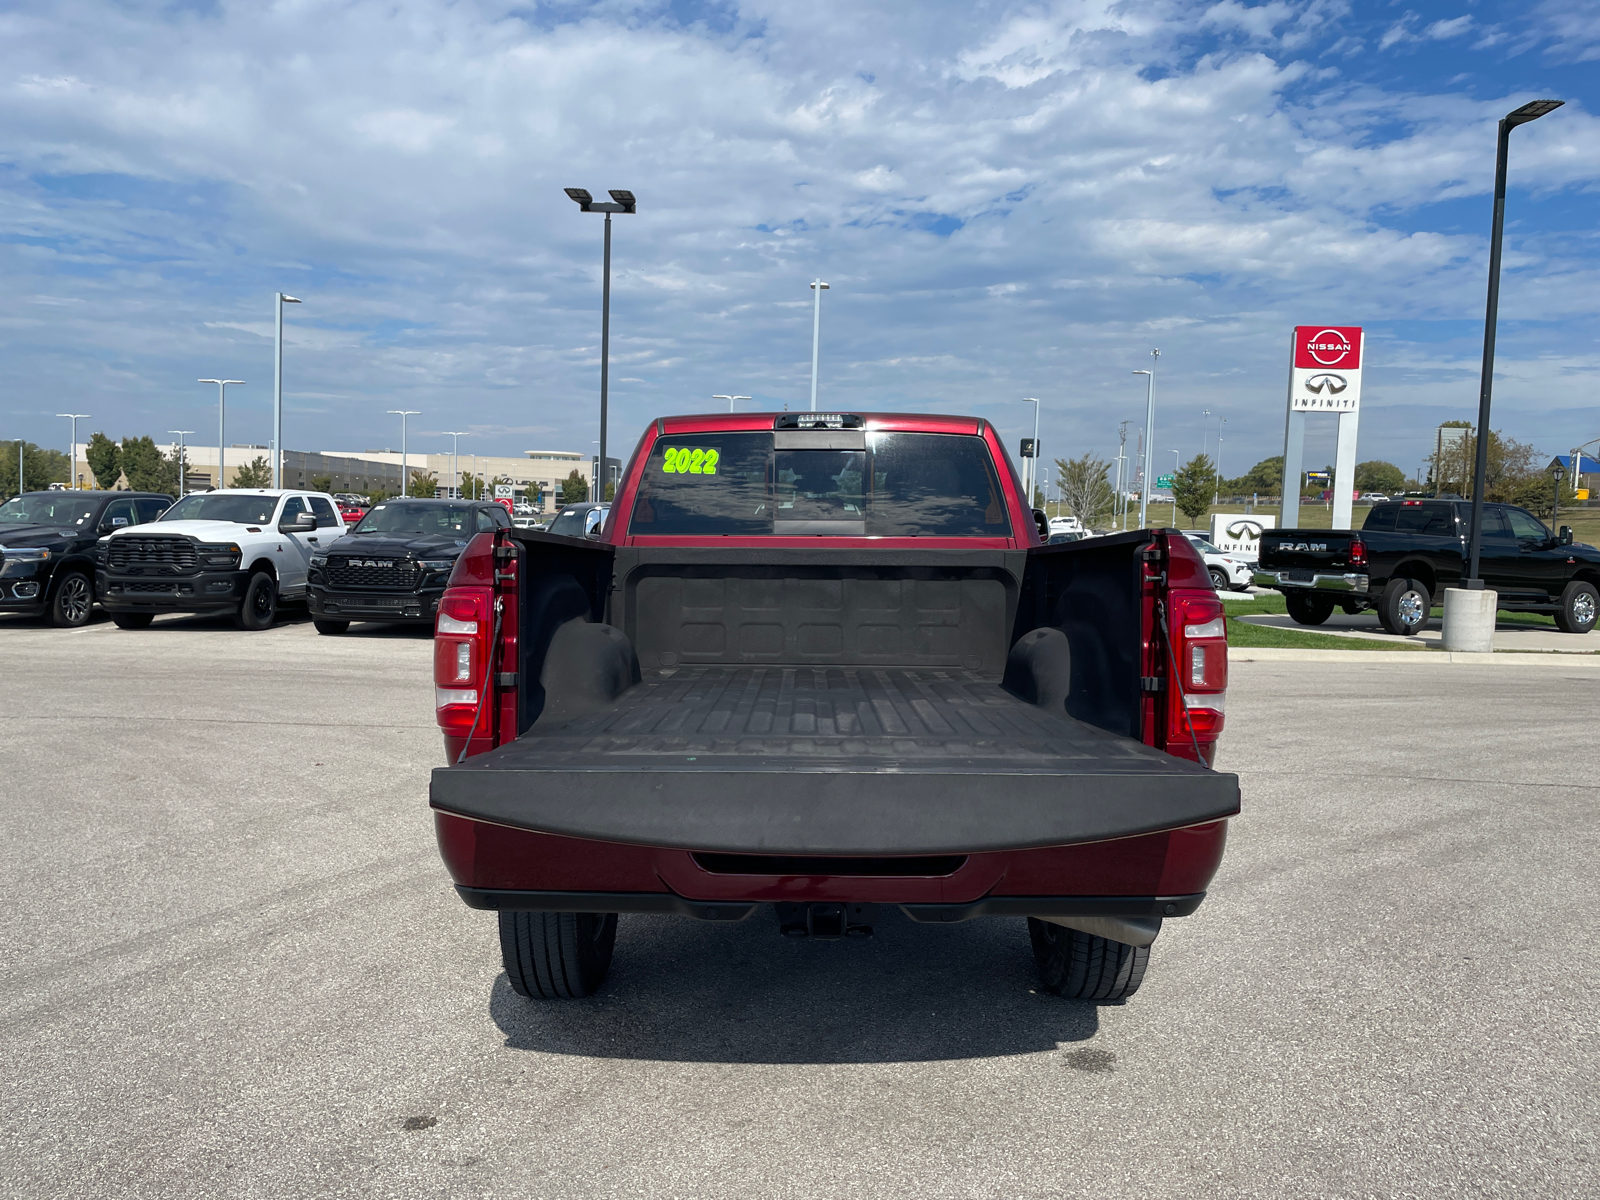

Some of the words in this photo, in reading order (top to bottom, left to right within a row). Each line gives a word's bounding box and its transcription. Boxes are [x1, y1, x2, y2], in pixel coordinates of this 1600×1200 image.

[1307, 343, 1351, 351] NISSAN
[1294, 398, 1355, 408] INFINITI
[662, 447, 720, 475] 2022
[1279, 542, 1327, 552] RAM
[348, 559, 393, 568] RAM
